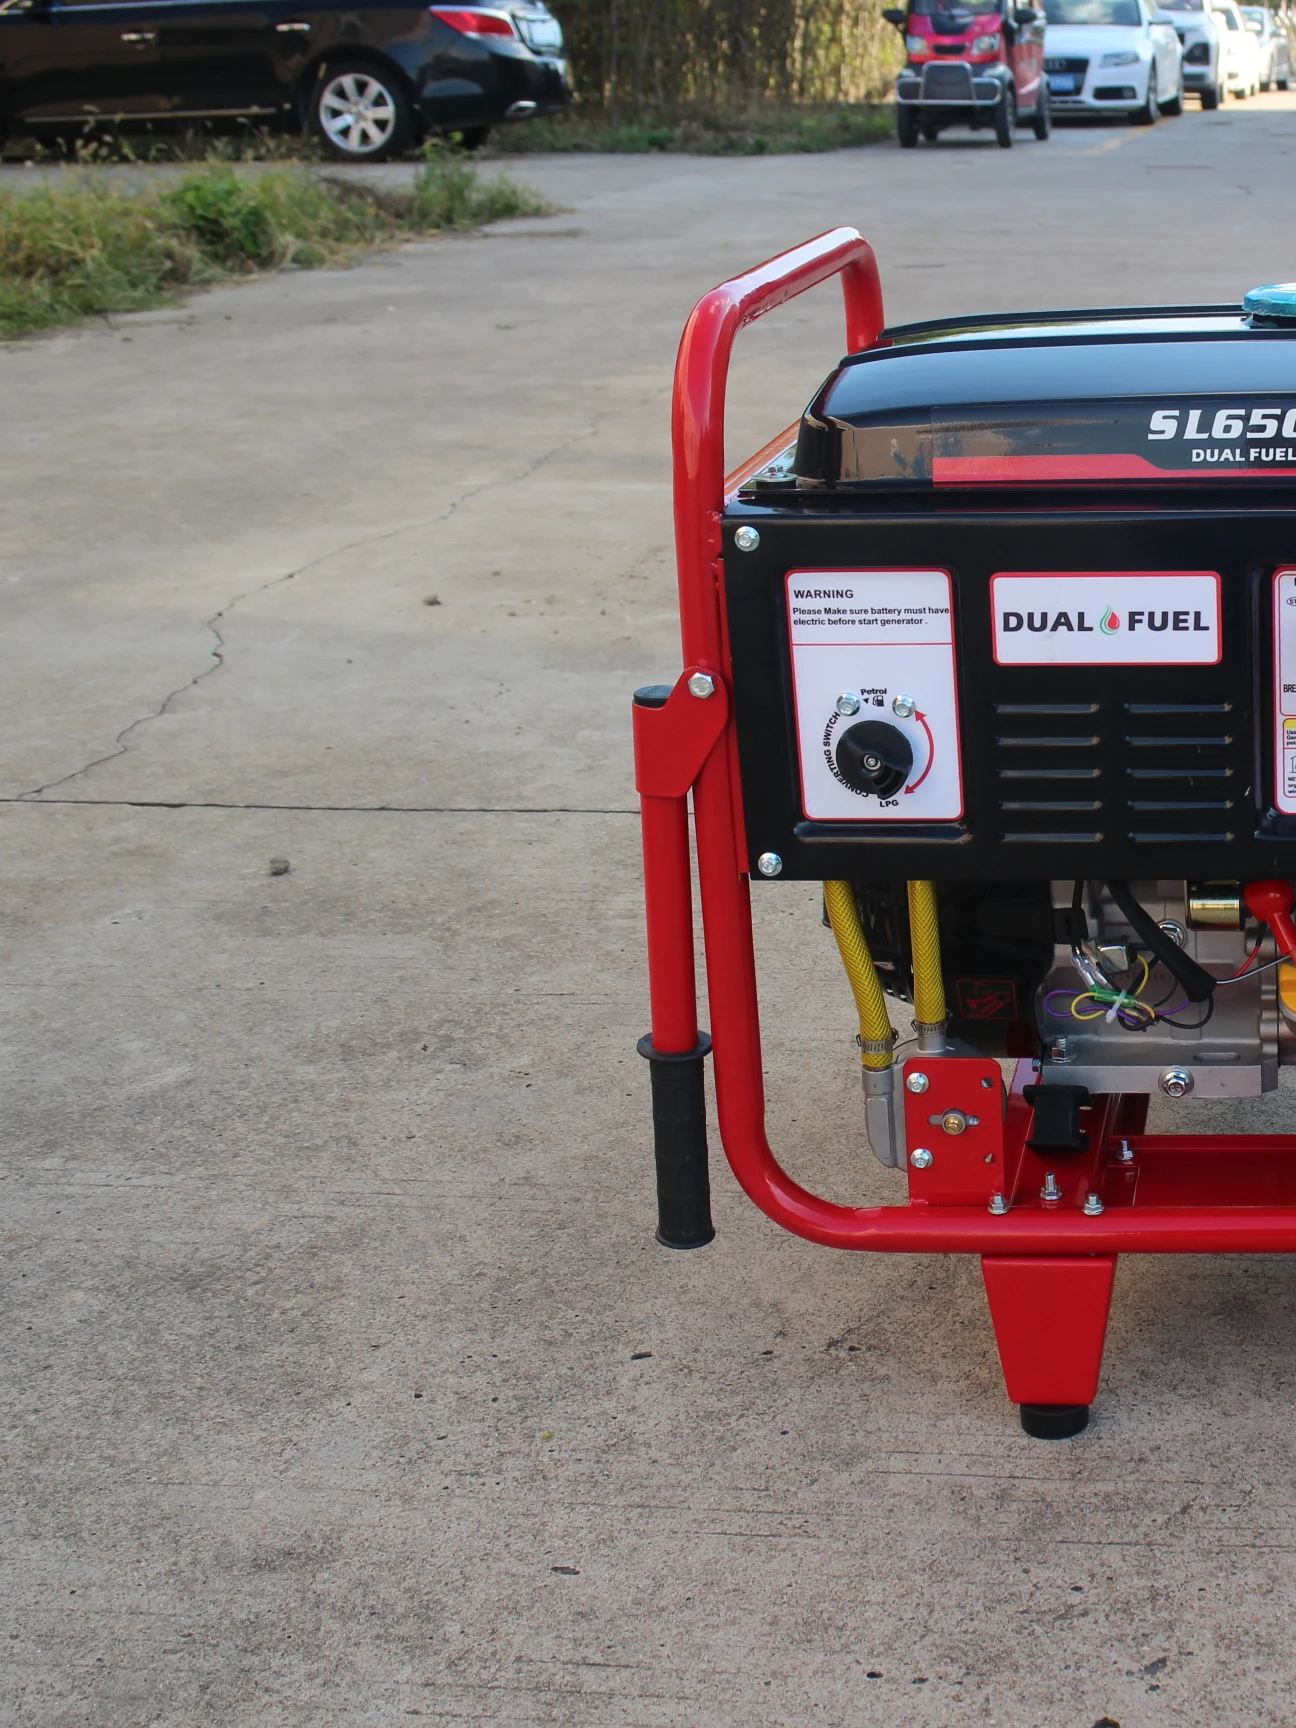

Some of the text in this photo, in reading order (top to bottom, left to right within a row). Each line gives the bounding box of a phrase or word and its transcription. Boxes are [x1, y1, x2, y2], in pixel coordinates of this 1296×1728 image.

[1191, 448, 1247, 463] DUAL
[793, 589, 854, 599] WARNING
[793, 607, 822, 616] Please
[824, 607, 847, 615] Make
[871, 607, 902, 617] battery
[904, 607, 930, 615] must
[932, 606, 950, 615] have
[793, 618, 826, 626] electric
[828, 617, 857, 626] before
[858, 618, 879, 626] start
[1003, 610, 1210, 633] DUAL FUEL
[860, 688, 888, 696] Petrol
[822, 711, 841, 747] SWITCH
[879, 799, 899, 807] LPG
